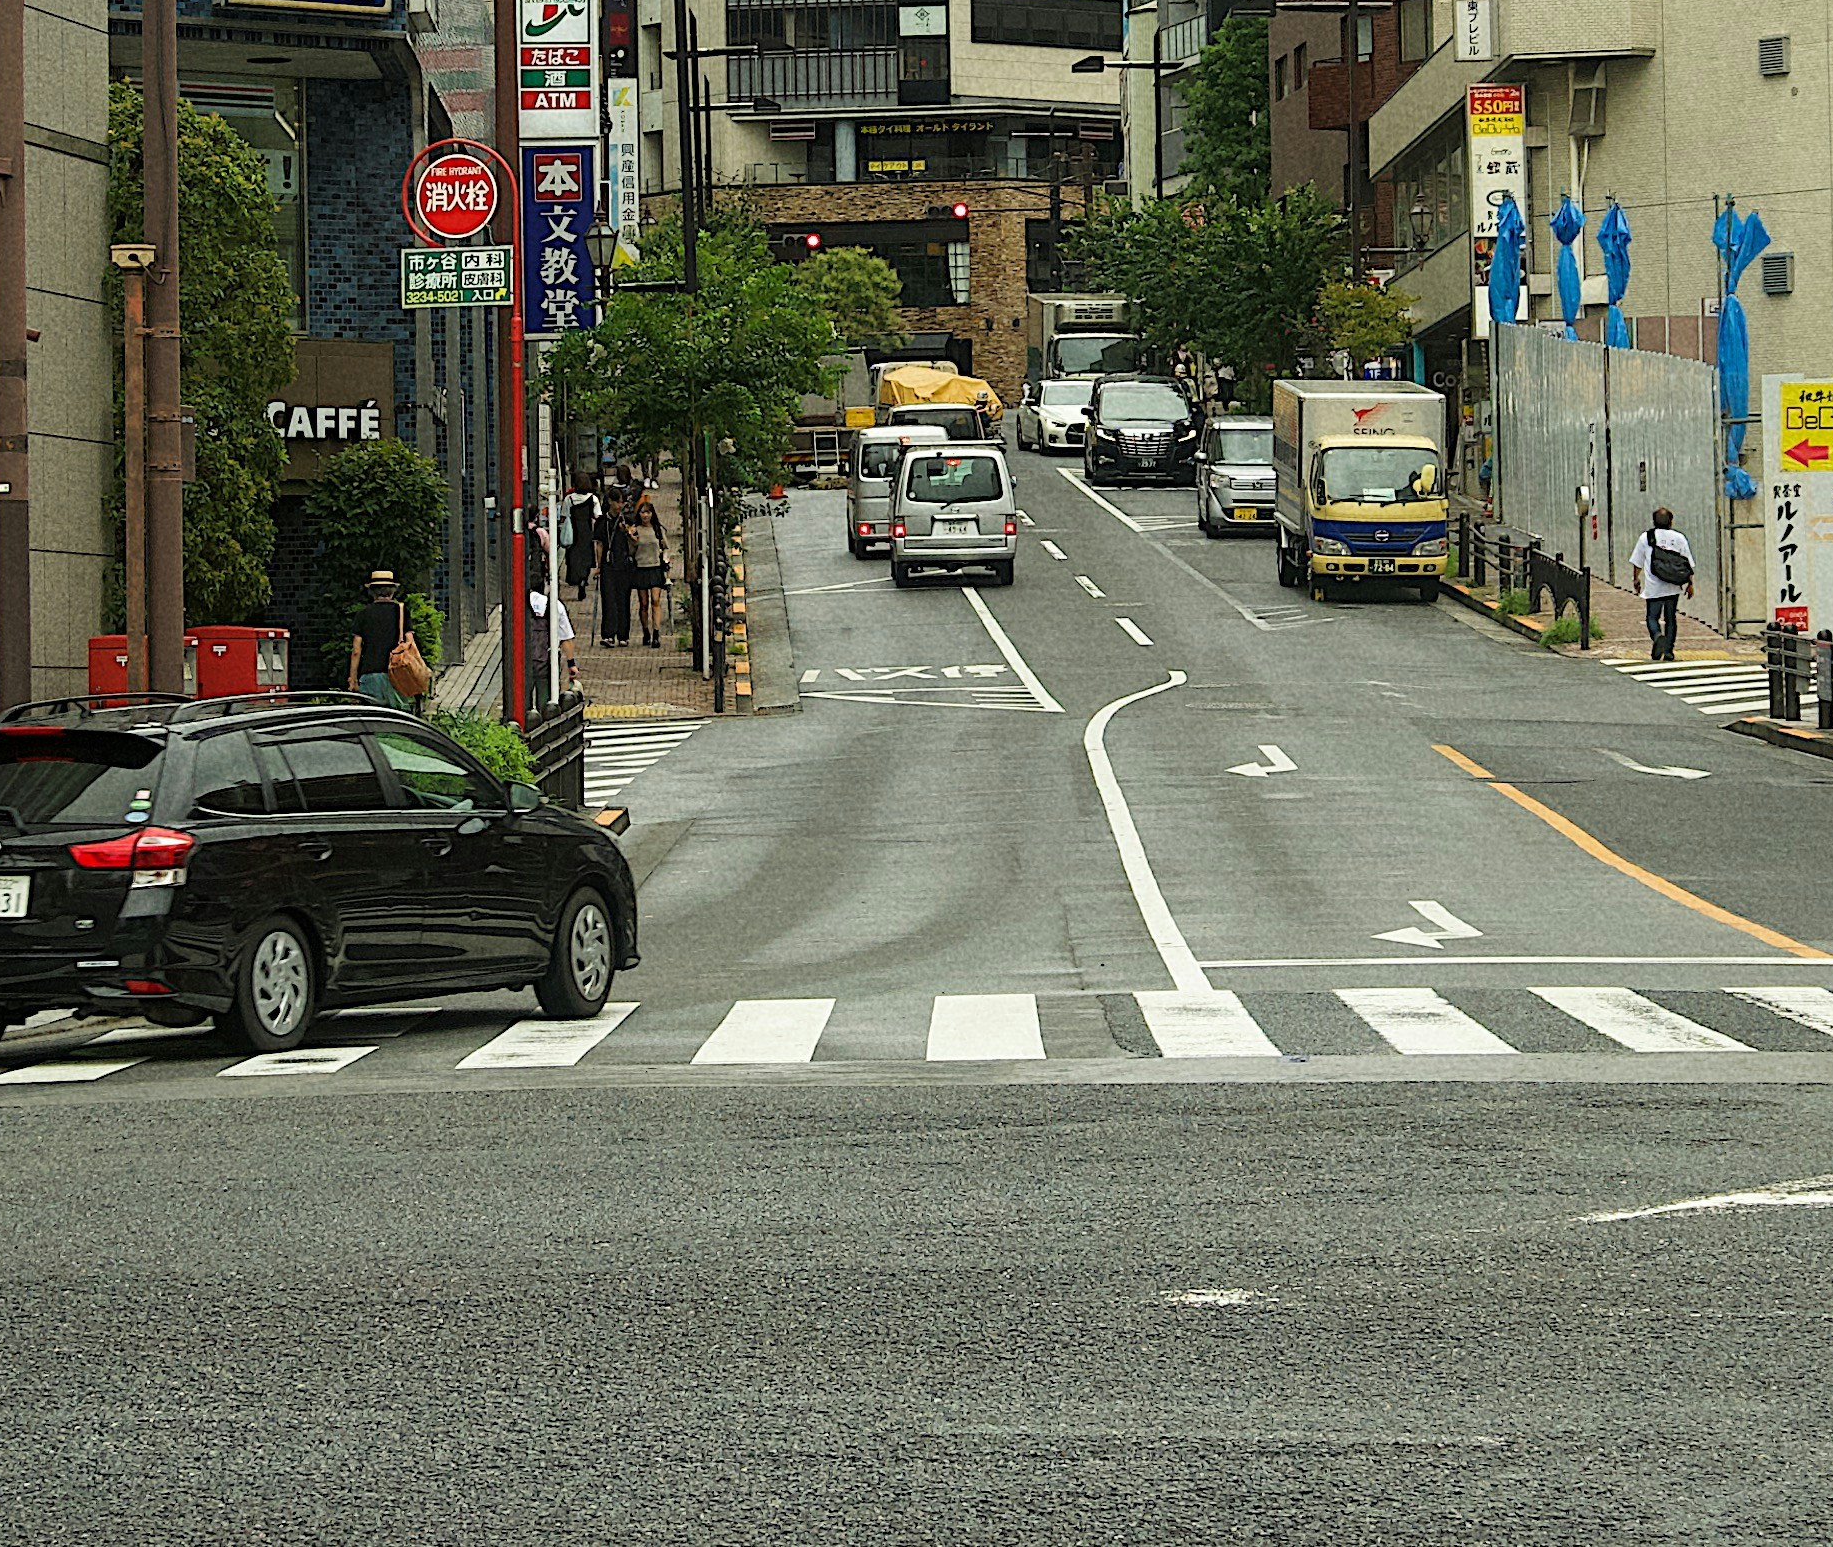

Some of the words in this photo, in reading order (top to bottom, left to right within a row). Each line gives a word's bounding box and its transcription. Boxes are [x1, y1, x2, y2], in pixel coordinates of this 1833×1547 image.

[531, 47, 581, 66] たばこ
[544, 70, 567, 88] 酒
[534, 92, 577, 109] ATM
[430, 167, 448, 177] FIRE
[449, 165, 483, 177] HYDRANT
[537, 161, 580, 195] 本
[425, 179, 490, 213] 消火栓
[464, 253, 503, 267] 内科
[539, 204, 578, 329] 文教堂
[407, 273, 458, 291] 診療所
[463, 271, 503, 286] 皮膚科
[406, 290, 464, 304] 3234-5021
[470, 290, 494, 302] 入口
[267, 399, 381, 440] CAFFÉ
[1777, 500, 1803, 603] ルノアール
